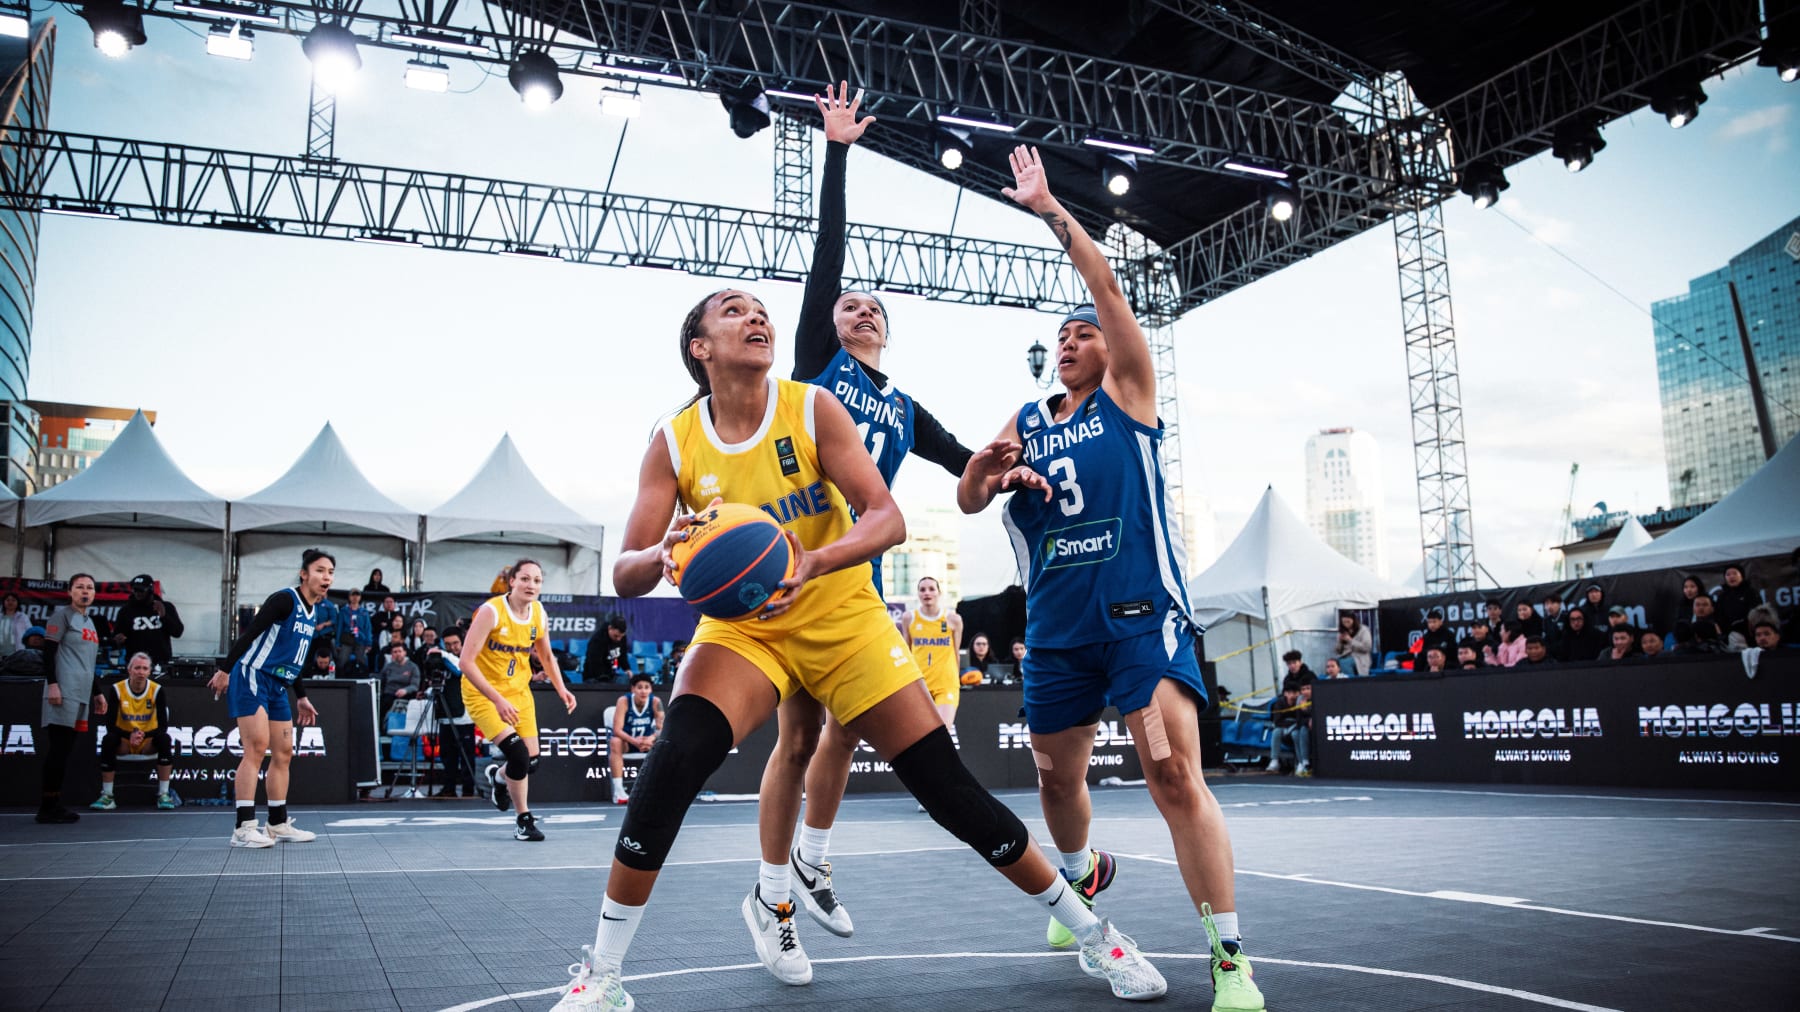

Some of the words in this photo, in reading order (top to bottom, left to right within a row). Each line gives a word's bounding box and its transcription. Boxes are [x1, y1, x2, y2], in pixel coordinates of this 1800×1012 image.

[1047, 456, 1085, 517] 3
[759, 479, 833, 525] AINE
[1056, 530, 1113, 556] Smart
[1141, 604, 1151, 612] XL
[547, 616, 597, 632] ERIES
[293, 638, 309, 666] 10
[507, 658, 516, 677] 8
[1326, 713, 1437, 741] MONGOLIA
[1463, 707, 1603, 740] MONGOLIA
[1638, 702, 1800, 738] MONGOLI
[1088, 754, 1124, 766] OVING
[1350, 750, 1378, 761] ALWAYS
[1379, 750, 1411, 761] MOVING
[1495, 749, 1530, 762] ALWAYS
[1532, 749, 1571, 762] MOVING
[1679, 751, 1724, 764] ALWAYS
[1727, 751, 1780, 764] MOVING
[150, 769, 208, 780] AWAYS
[850, 762, 872, 773] AYS
